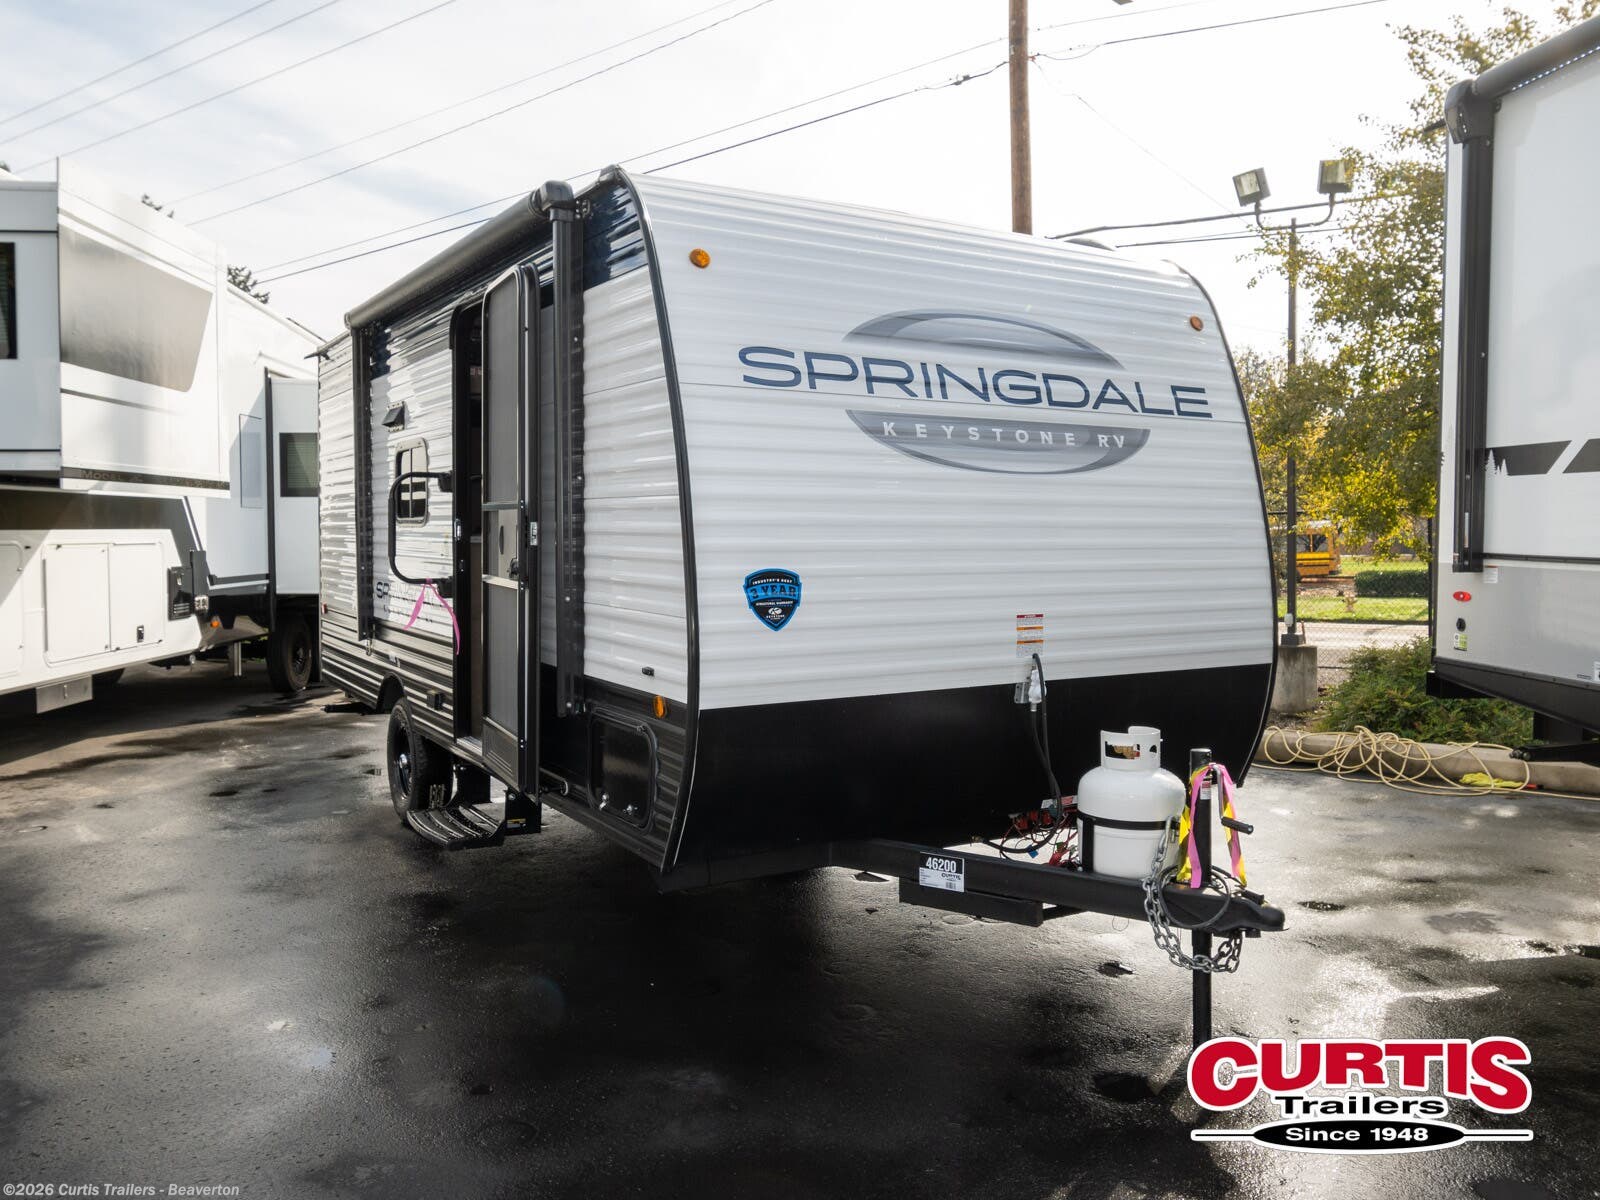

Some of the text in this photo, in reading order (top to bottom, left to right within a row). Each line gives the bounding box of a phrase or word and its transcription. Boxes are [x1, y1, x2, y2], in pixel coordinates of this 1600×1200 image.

[738, 345, 1212, 418] SPRINGDALE
[883, 421, 1125, 449] KEYSTONE RV
[750, 585, 796, 598] 3 YEAR
[926, 857, 957, 873] 46200
